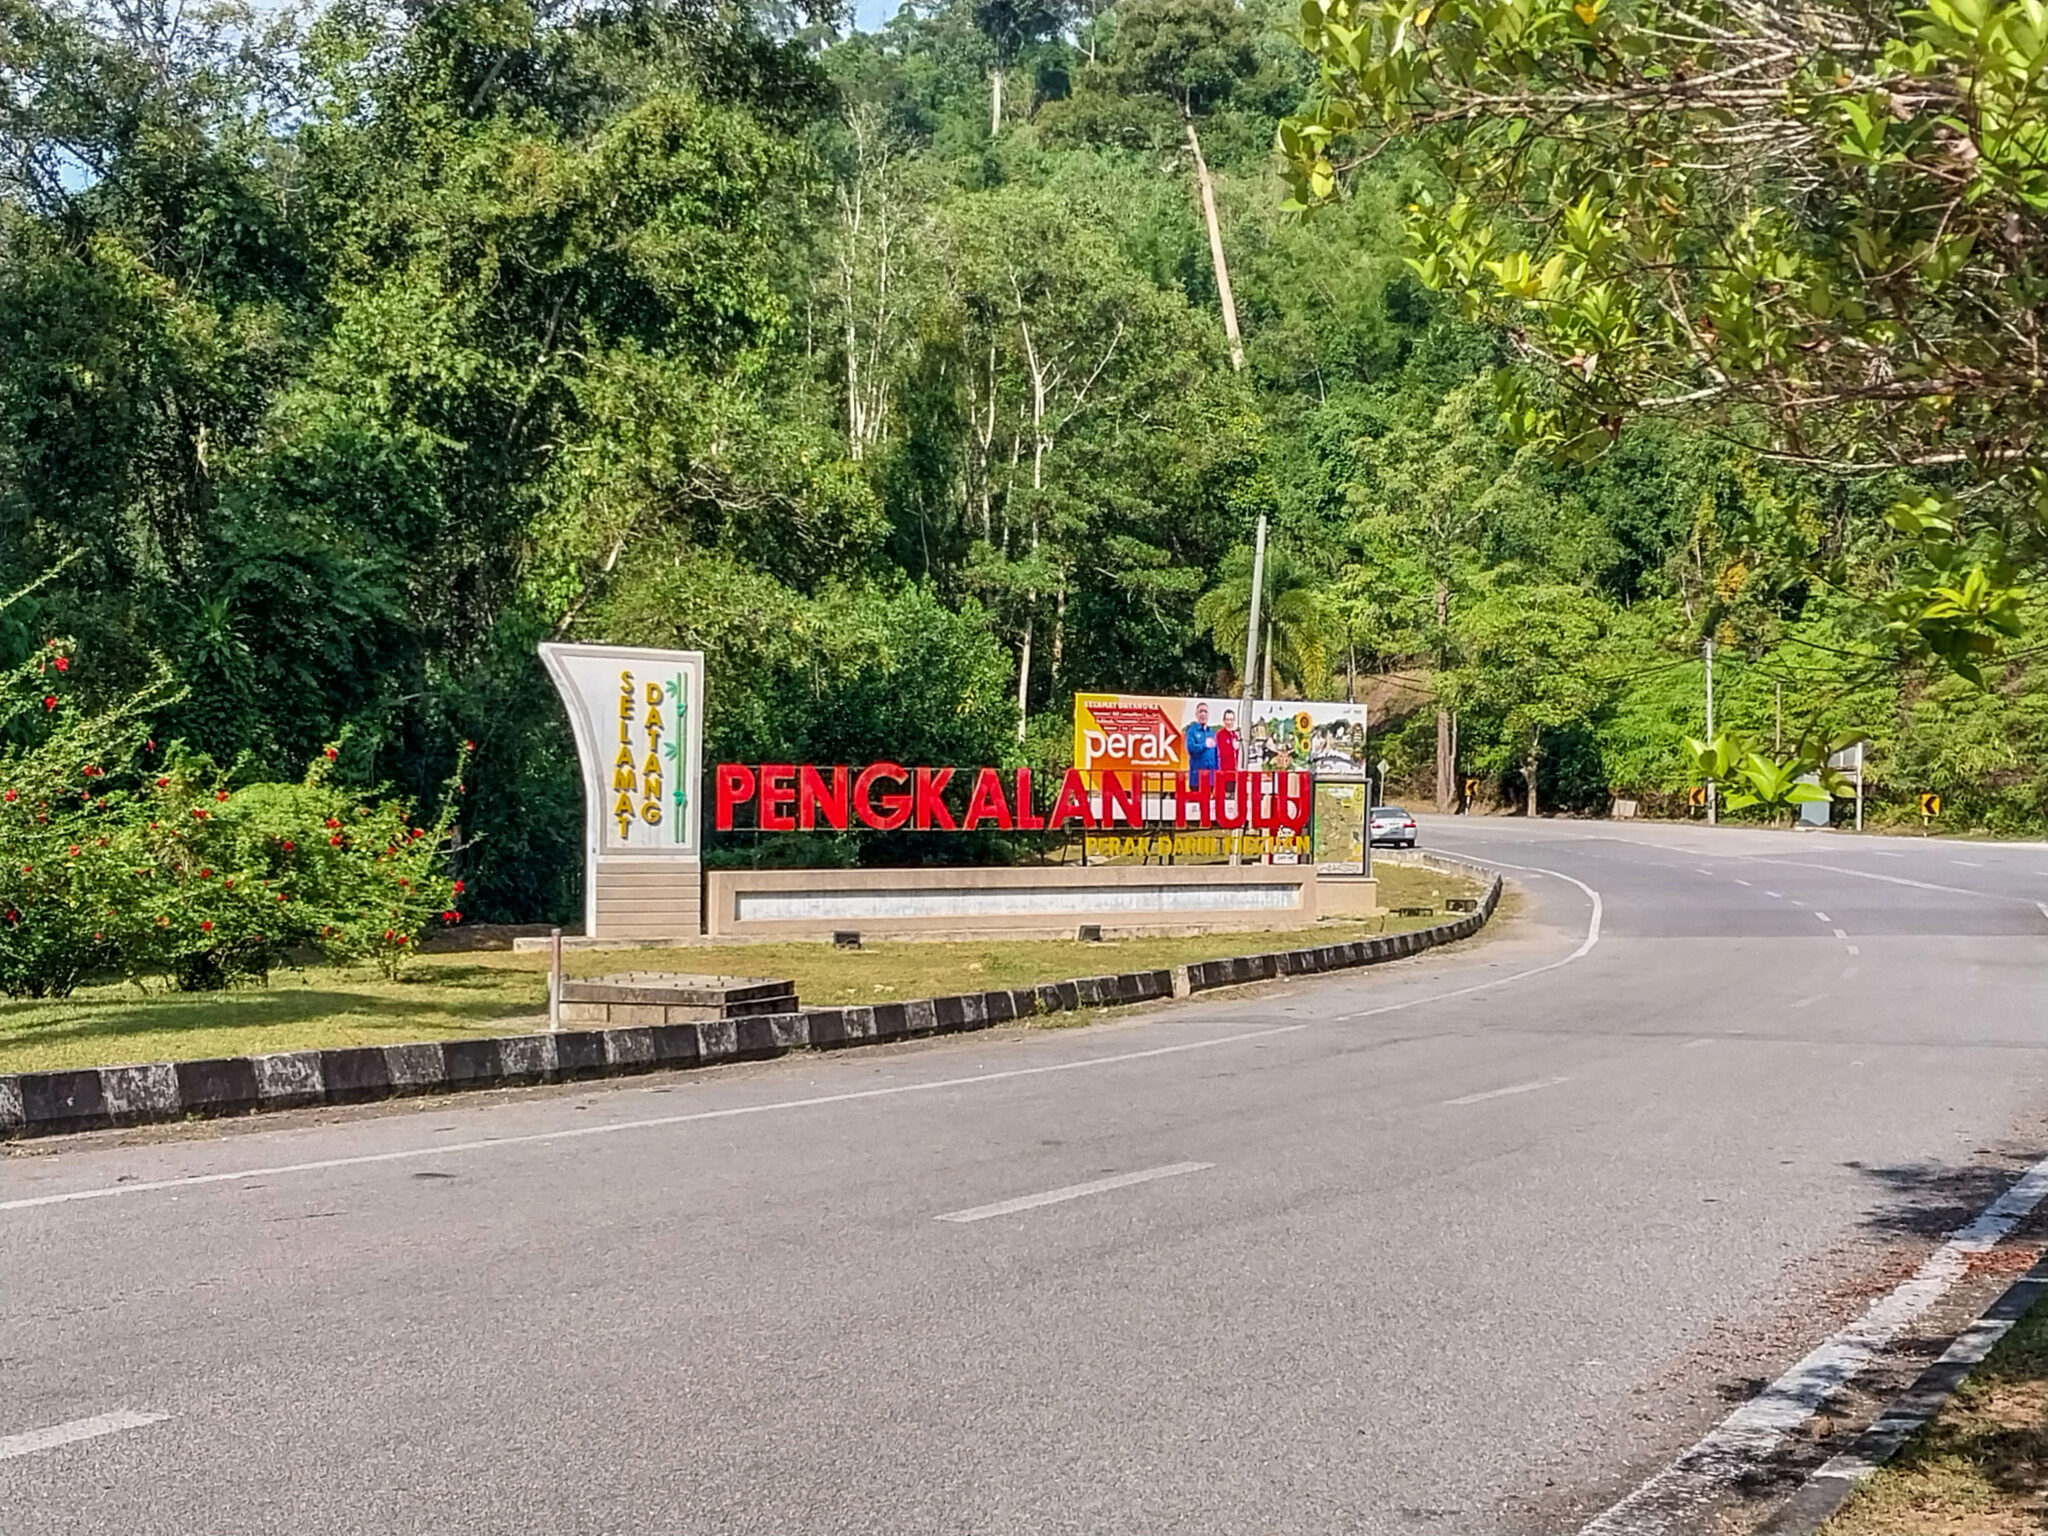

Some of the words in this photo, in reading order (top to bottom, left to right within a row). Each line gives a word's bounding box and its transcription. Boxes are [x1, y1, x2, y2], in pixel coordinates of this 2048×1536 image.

[613, 670, 637, 839] SELAMAT
[640, 682, 663, 825] DATANG
[1083, 723, 1179, 769] perak
[715, 762, 1144, 831] PENGKALAN
[1175, 770, 1310, 829] HULU
[1085, 836, 1150, 856] PERAK
